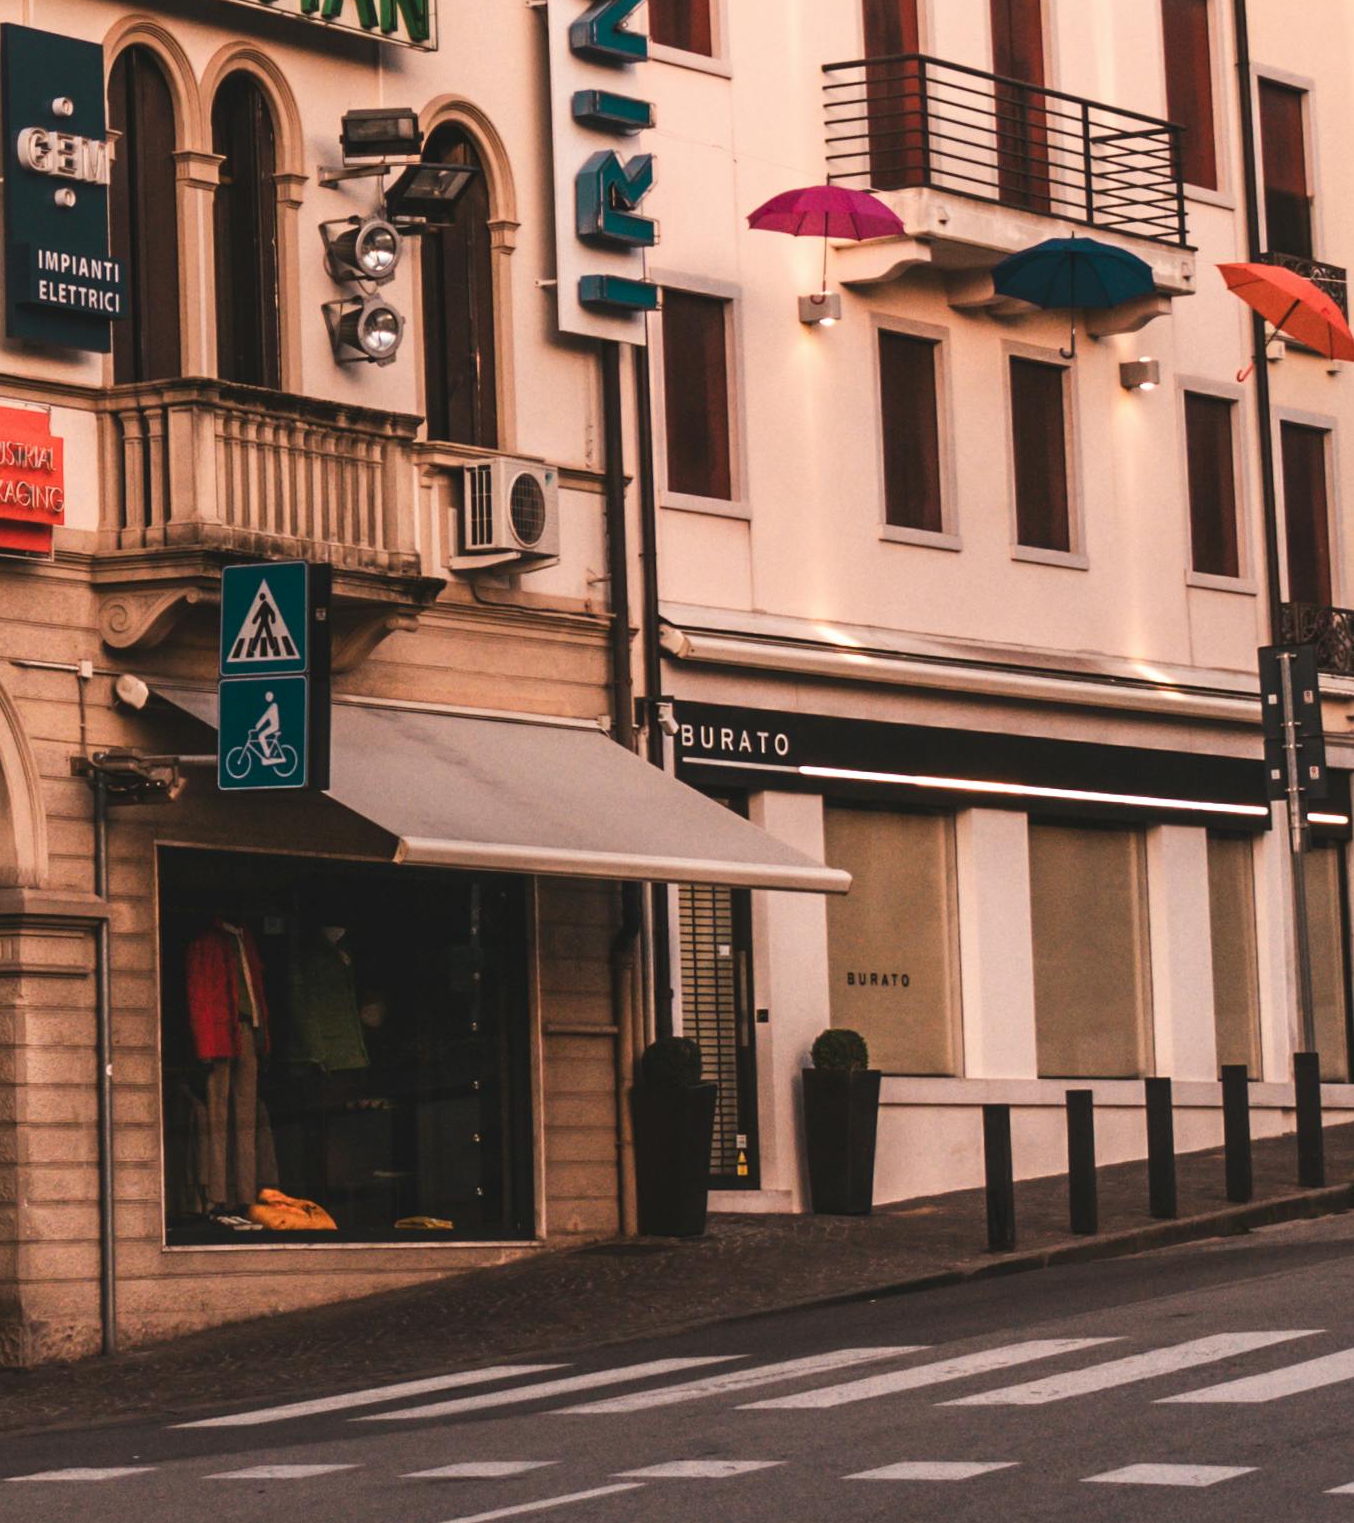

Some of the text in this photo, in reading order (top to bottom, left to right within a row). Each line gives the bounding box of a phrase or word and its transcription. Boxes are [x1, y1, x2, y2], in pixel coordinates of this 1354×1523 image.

[38, 249, 121, 284] IMPIANTI
[38, 280, 121, 314] ELETTRICI
[680, 723, 790, 756] BURATO
[846, 971, 910, 988] BURATO
